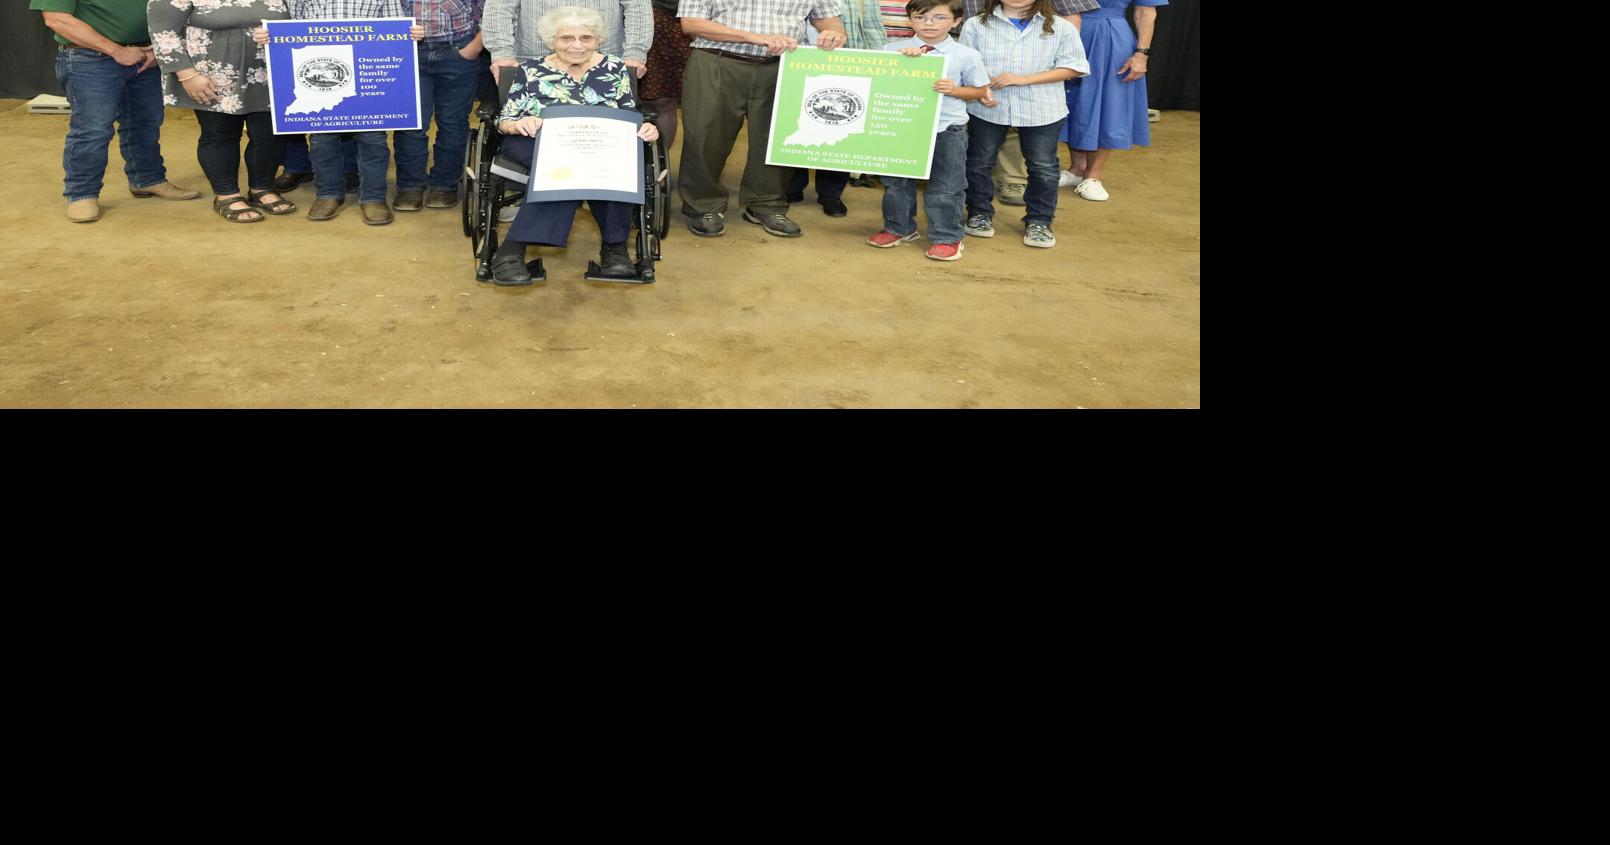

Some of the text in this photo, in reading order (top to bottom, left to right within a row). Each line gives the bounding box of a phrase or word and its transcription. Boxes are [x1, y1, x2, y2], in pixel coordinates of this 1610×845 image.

[307, 26, 374, 34] HOOSIER
[273, 34, 408, 44] HOMESTEAD FARM
[827, 55, 898, 67] HOOSIER
[789, 61, 936, 79] HOMESTEAD FARM
[874, 93, 925, 104] Owned by
[872, 106, 904, 116] family
[867, 129, 897, 137] years
[781, 147, 920, 166] INDIANA STATE DEPARTMENT
[821, 157, 889, 169] AGRICULTURE
